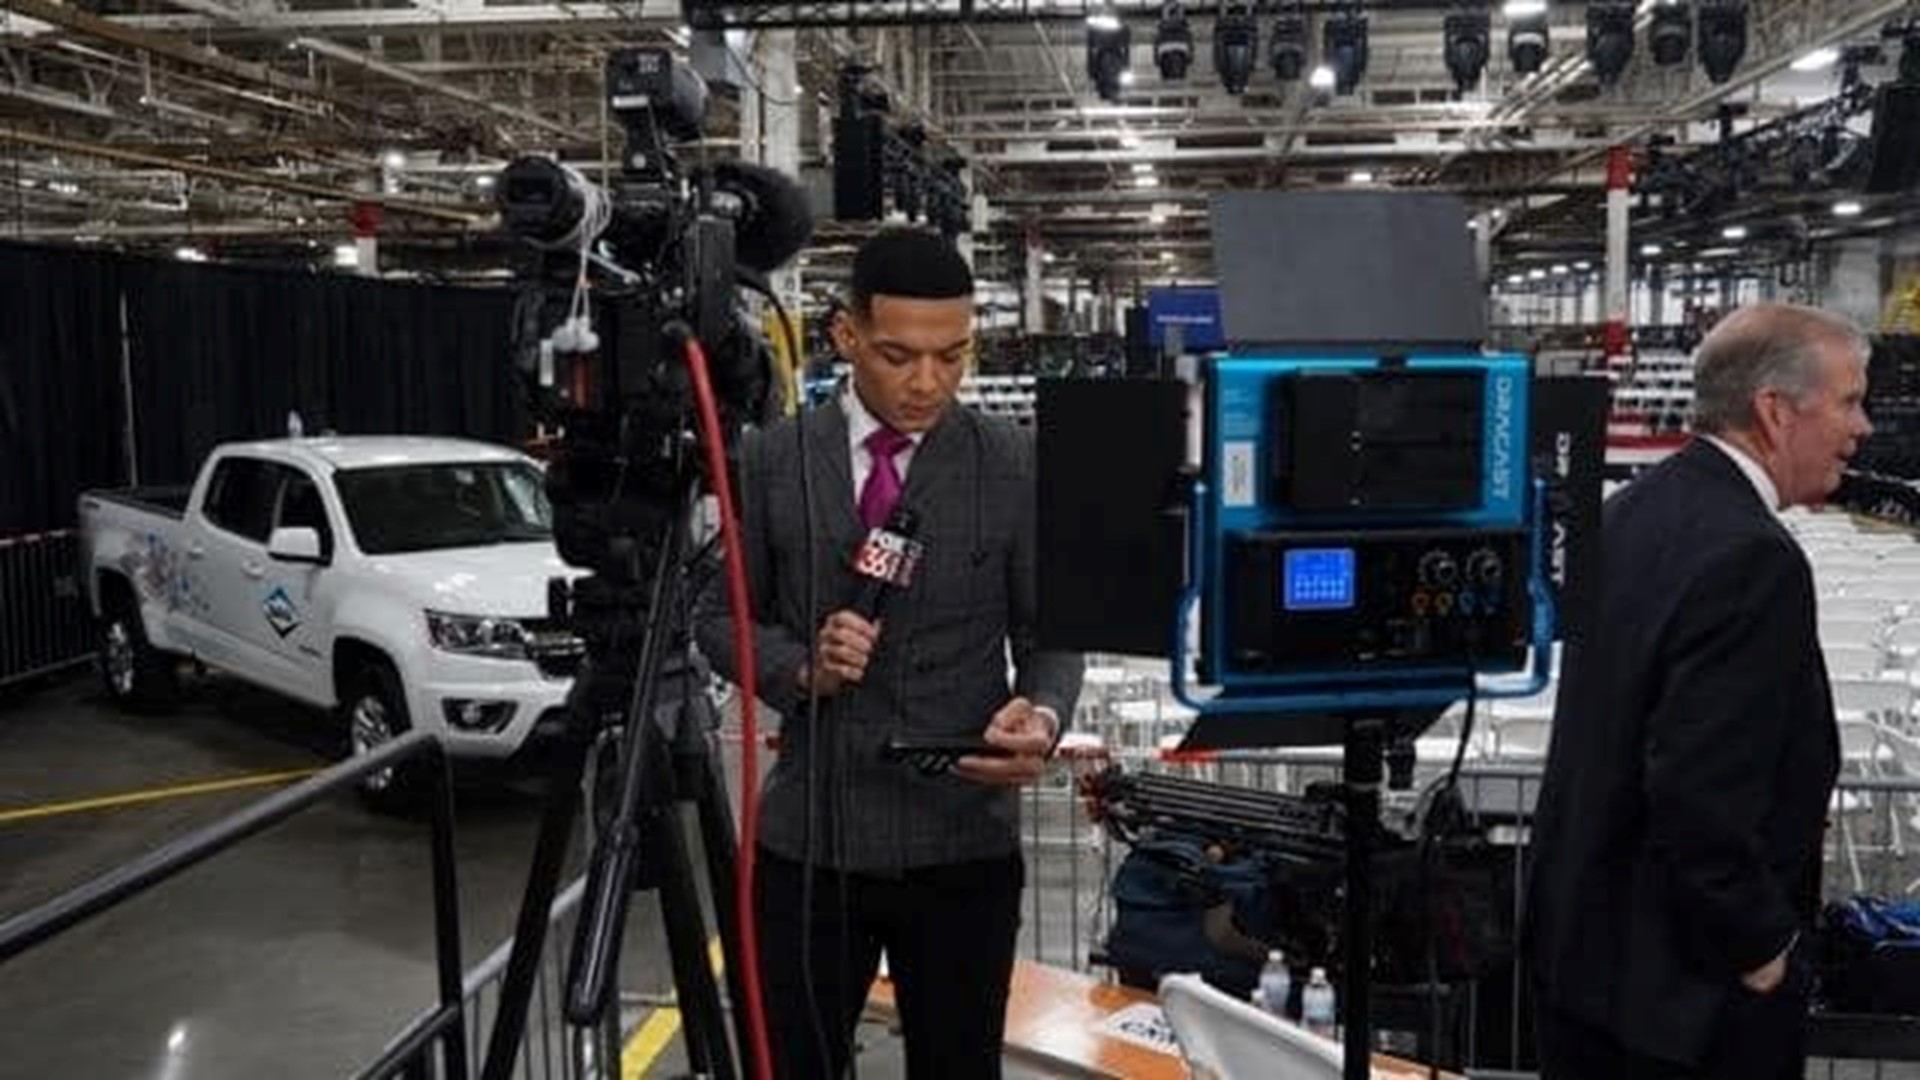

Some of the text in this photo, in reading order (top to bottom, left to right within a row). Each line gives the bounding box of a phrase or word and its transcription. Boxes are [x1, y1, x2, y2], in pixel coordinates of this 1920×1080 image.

[1492, 377, 1512, 499] DRACAST
[866, 528, 905, 557] FOX
[1551, 432, 1571, 586] DRAST
